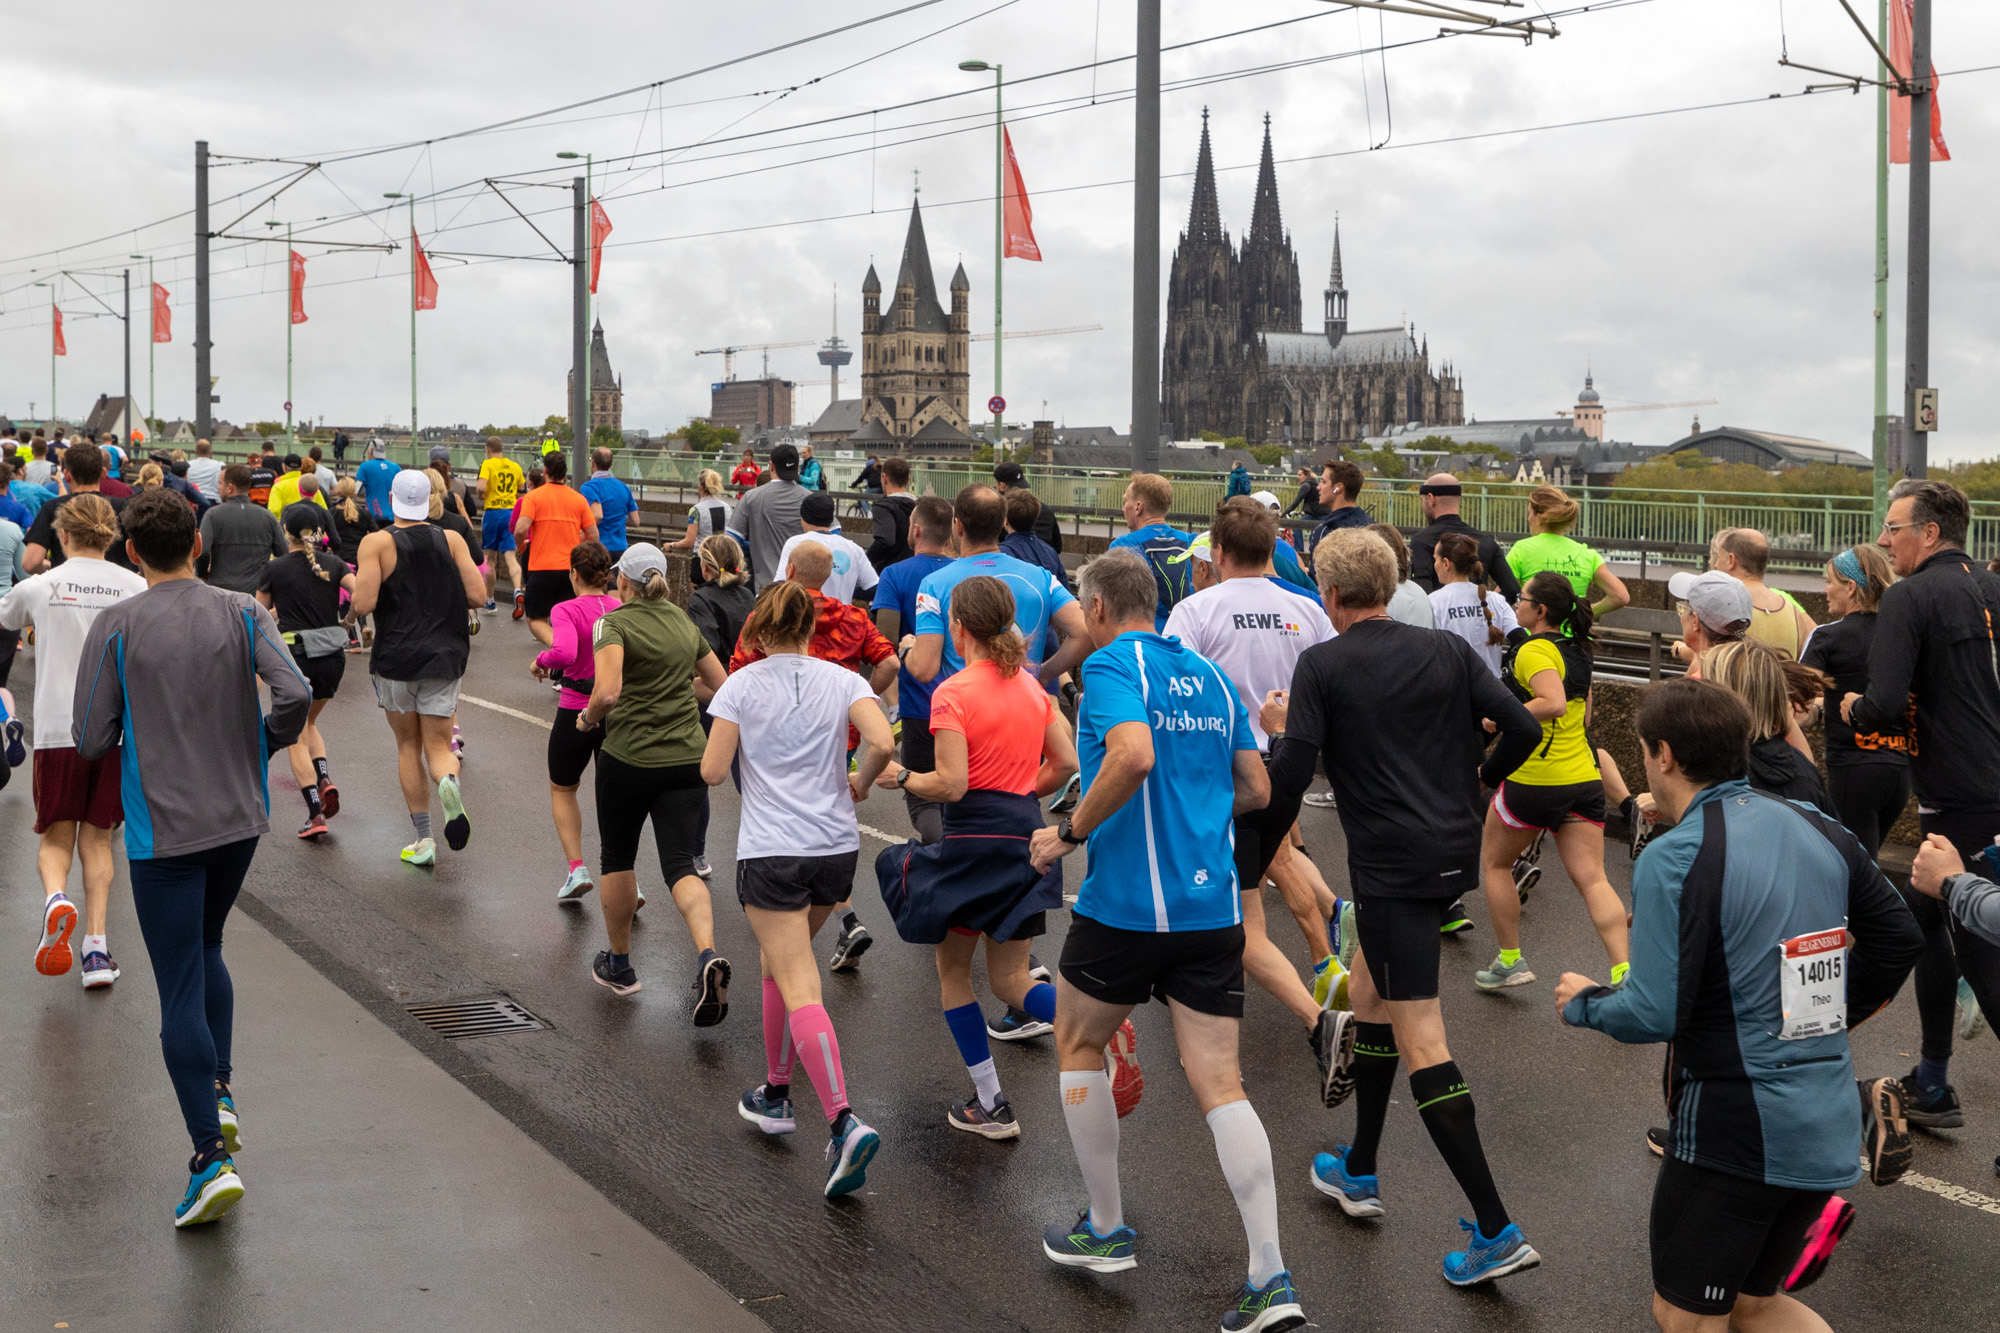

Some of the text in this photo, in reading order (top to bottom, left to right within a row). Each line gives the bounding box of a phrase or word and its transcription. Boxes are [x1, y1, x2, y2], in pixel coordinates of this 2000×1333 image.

[1920, 394, 1933, 425] 5
[497, 471, 515, 493] 32
[1232, 613, 1283, 630] REWE
[1448, 605, 1484, 620] REWE
[1168, 675, 1205, 697] ASV
[1797, 957, 1842, 986] 14015
[1811, 994, 1832, 1007] Theo
[1355, 1042, 1390, 1052] FALKE
